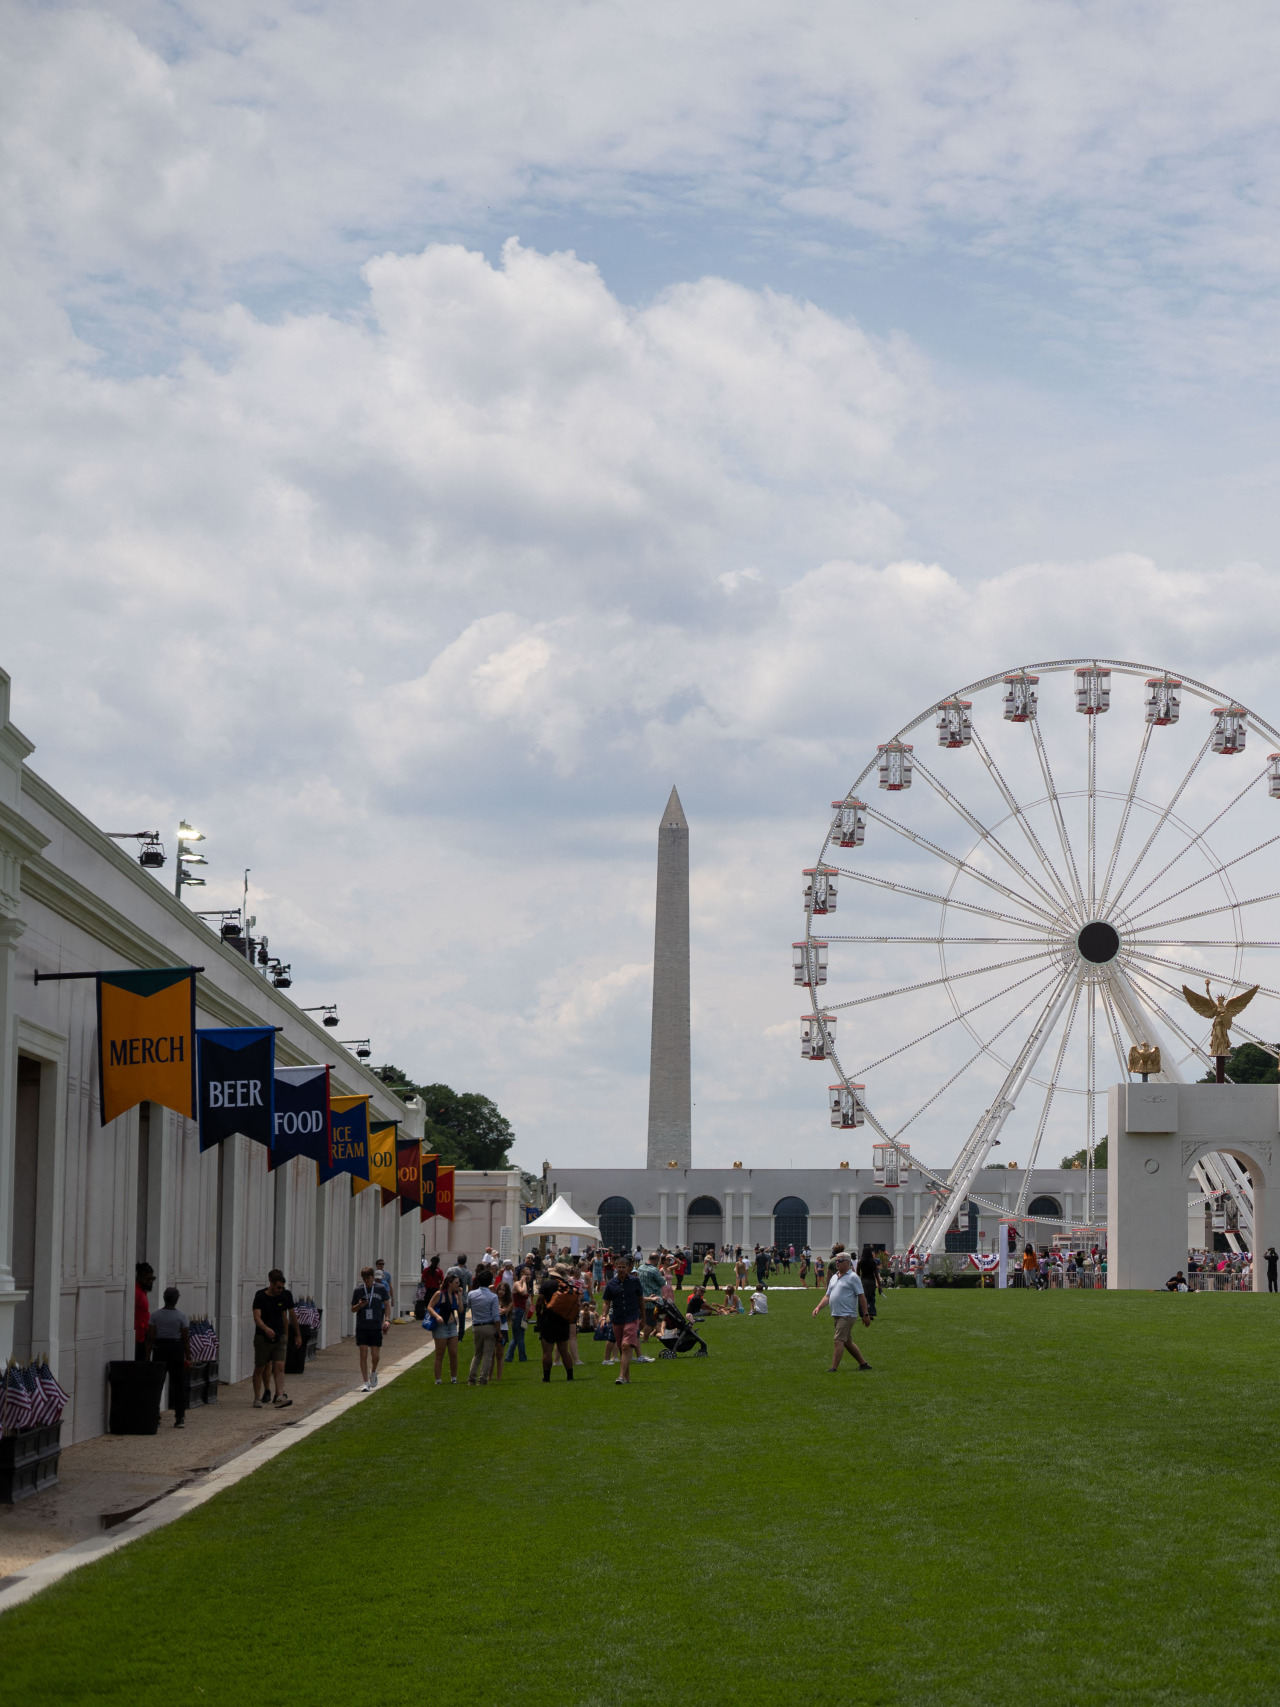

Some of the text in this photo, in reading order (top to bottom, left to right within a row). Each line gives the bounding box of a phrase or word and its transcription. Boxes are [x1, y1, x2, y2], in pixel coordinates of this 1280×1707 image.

[110, 1036, 184, 1066] MERCH
[209, 1079, 264, 1108] BEER
[274, 1110, 323, 1135] FOOD
[333, 1126, 352, 1142] ICE
[331, 1142, 365, 1159] REAM
